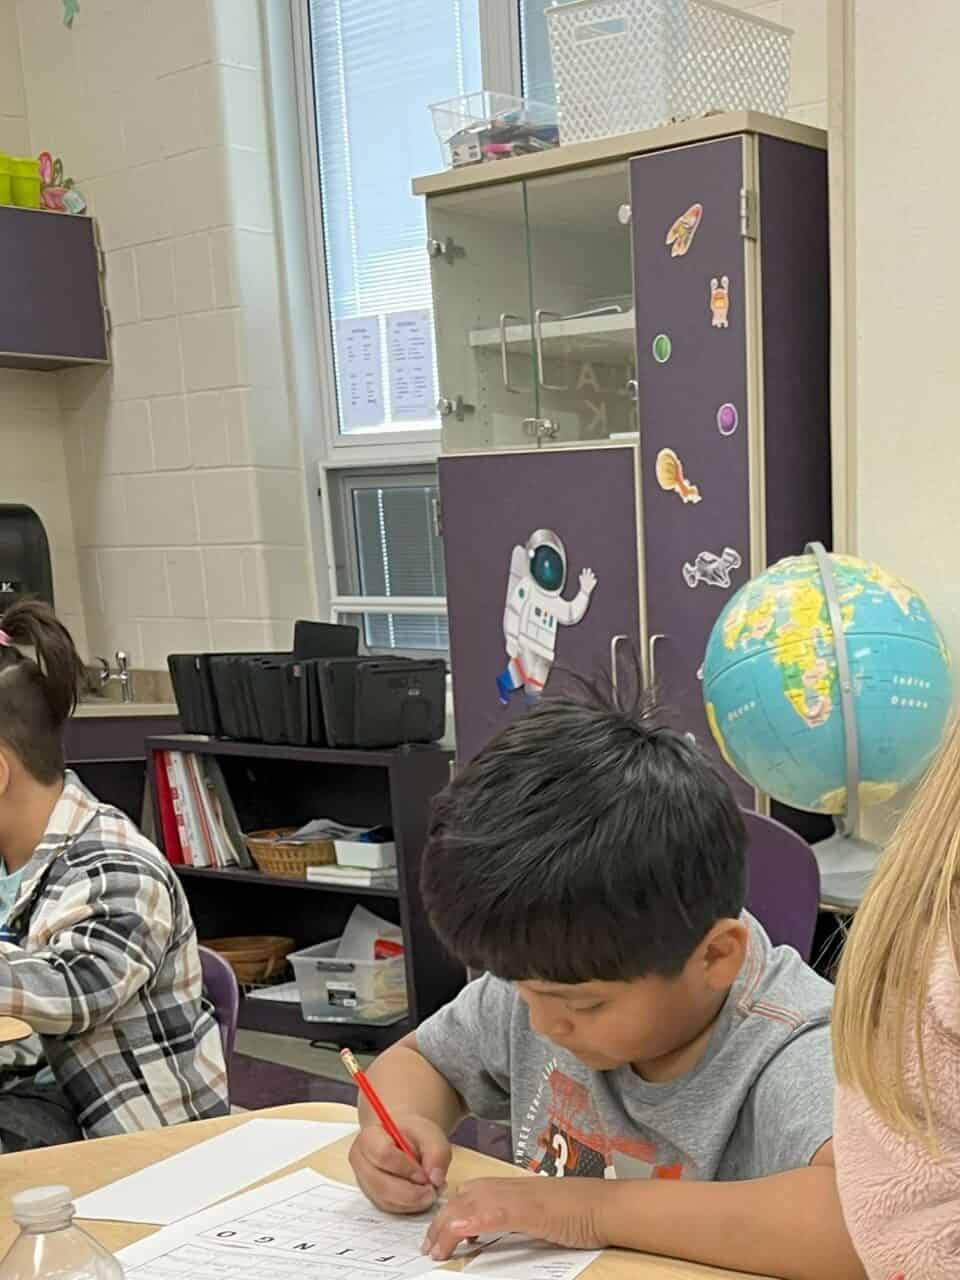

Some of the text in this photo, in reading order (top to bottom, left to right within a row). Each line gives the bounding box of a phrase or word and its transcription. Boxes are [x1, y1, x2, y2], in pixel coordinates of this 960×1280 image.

[216, 1230, 237, 1238] O
[254, 1236, 275, 1244] G
[292, 1241, 316, 1251] N
[375, 1254, 396, 1263] F
